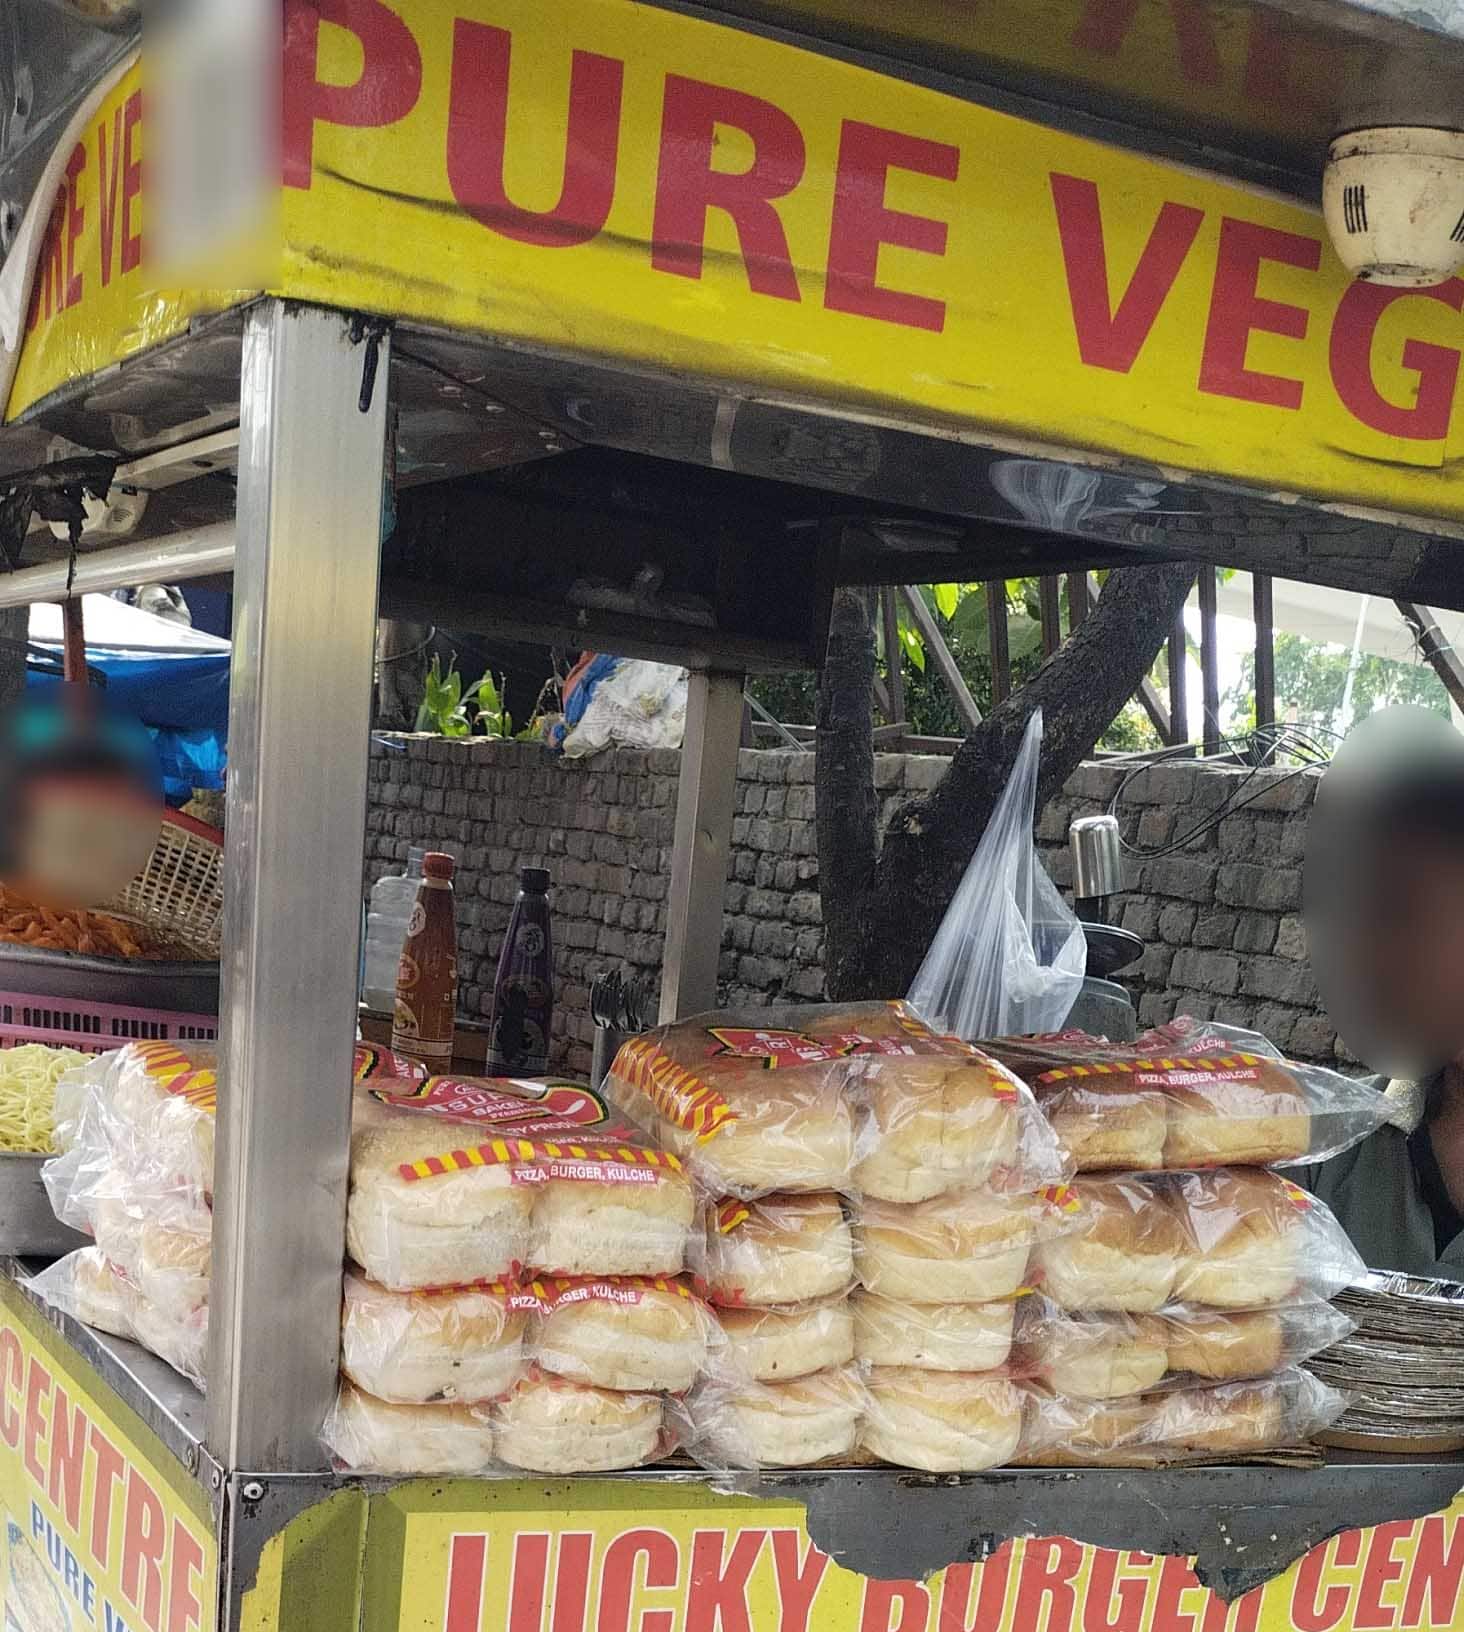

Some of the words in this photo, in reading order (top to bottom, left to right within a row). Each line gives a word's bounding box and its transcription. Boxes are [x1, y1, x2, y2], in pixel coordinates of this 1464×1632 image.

[27, 141, 87, 333] RE
[279, 0, 961, 334] PURE
[1049, 172, 1464, 441] VEG
[607, 1169, 655, 1182] KULCHE
[592, 1285, 637, 1303] KULCHE
[30, 1499, 97, 1625] PURE
